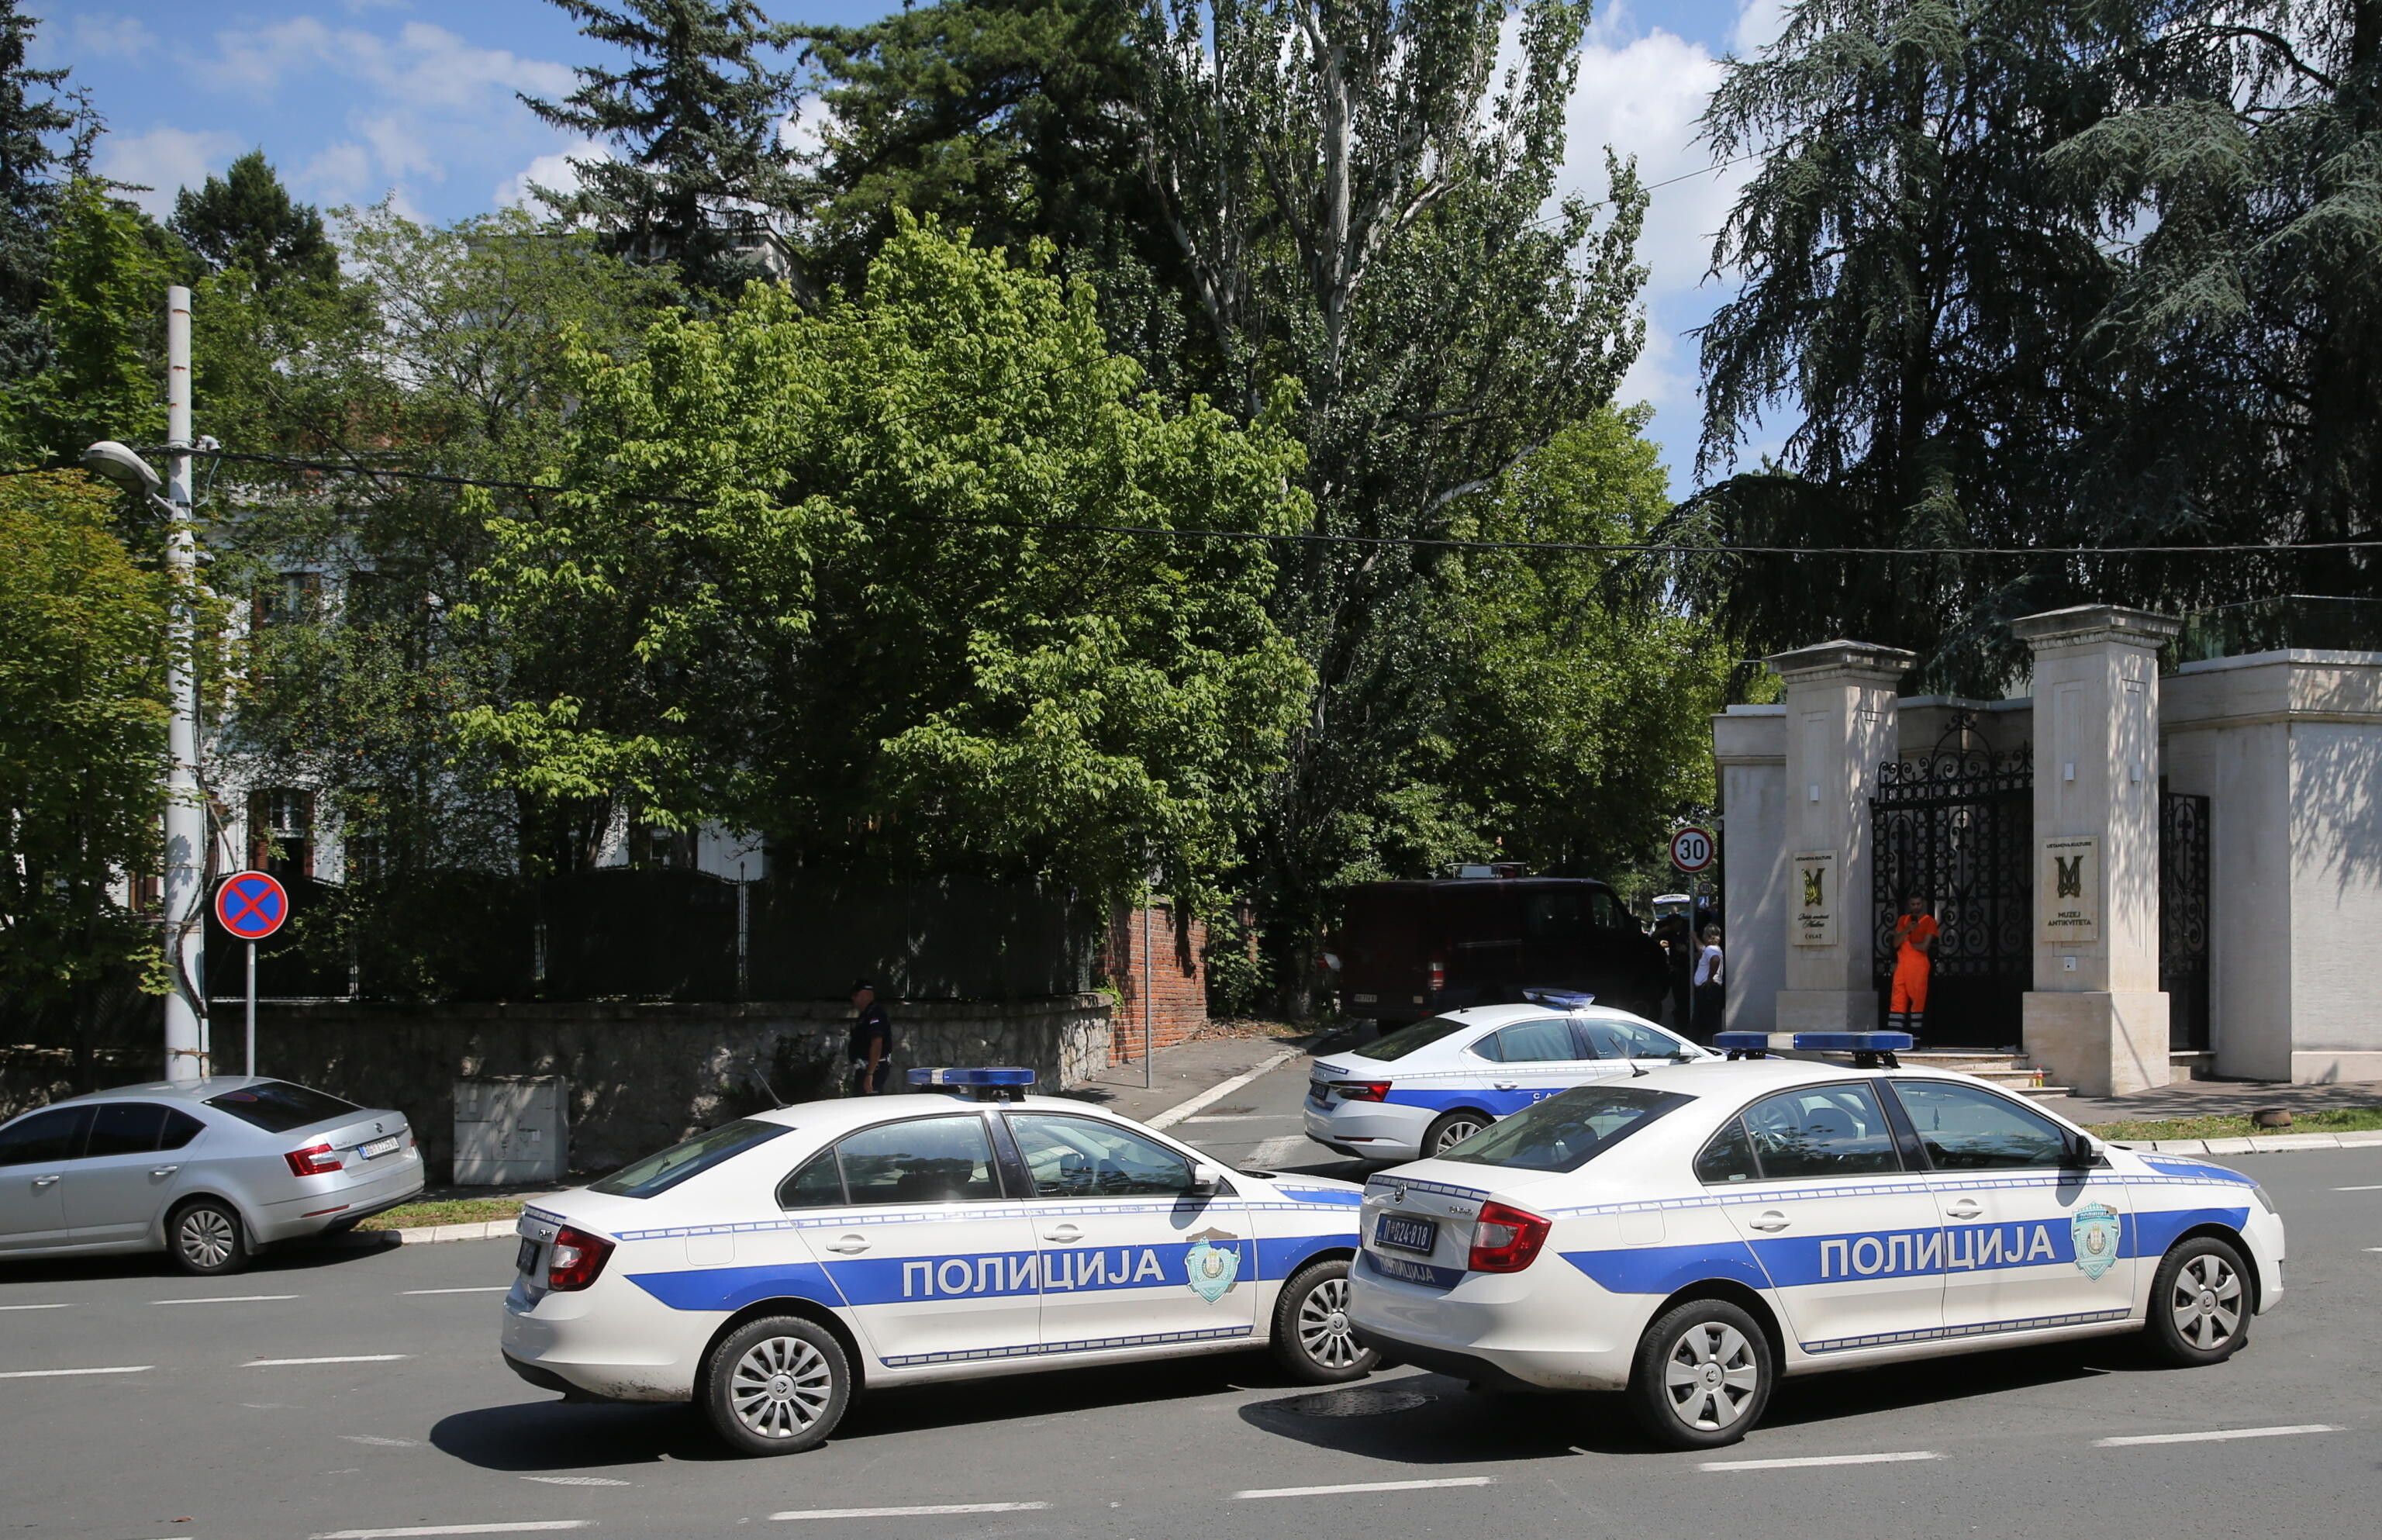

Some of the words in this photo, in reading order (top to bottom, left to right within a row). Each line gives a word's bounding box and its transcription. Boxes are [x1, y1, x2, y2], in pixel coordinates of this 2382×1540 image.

[1680, 839, 1704, 860] 30
[902, 1248, 1166, 1297] ПОЛИЦИЈА
[1820, 1224, 2056, 1278] ПОЛИЦИЈА
